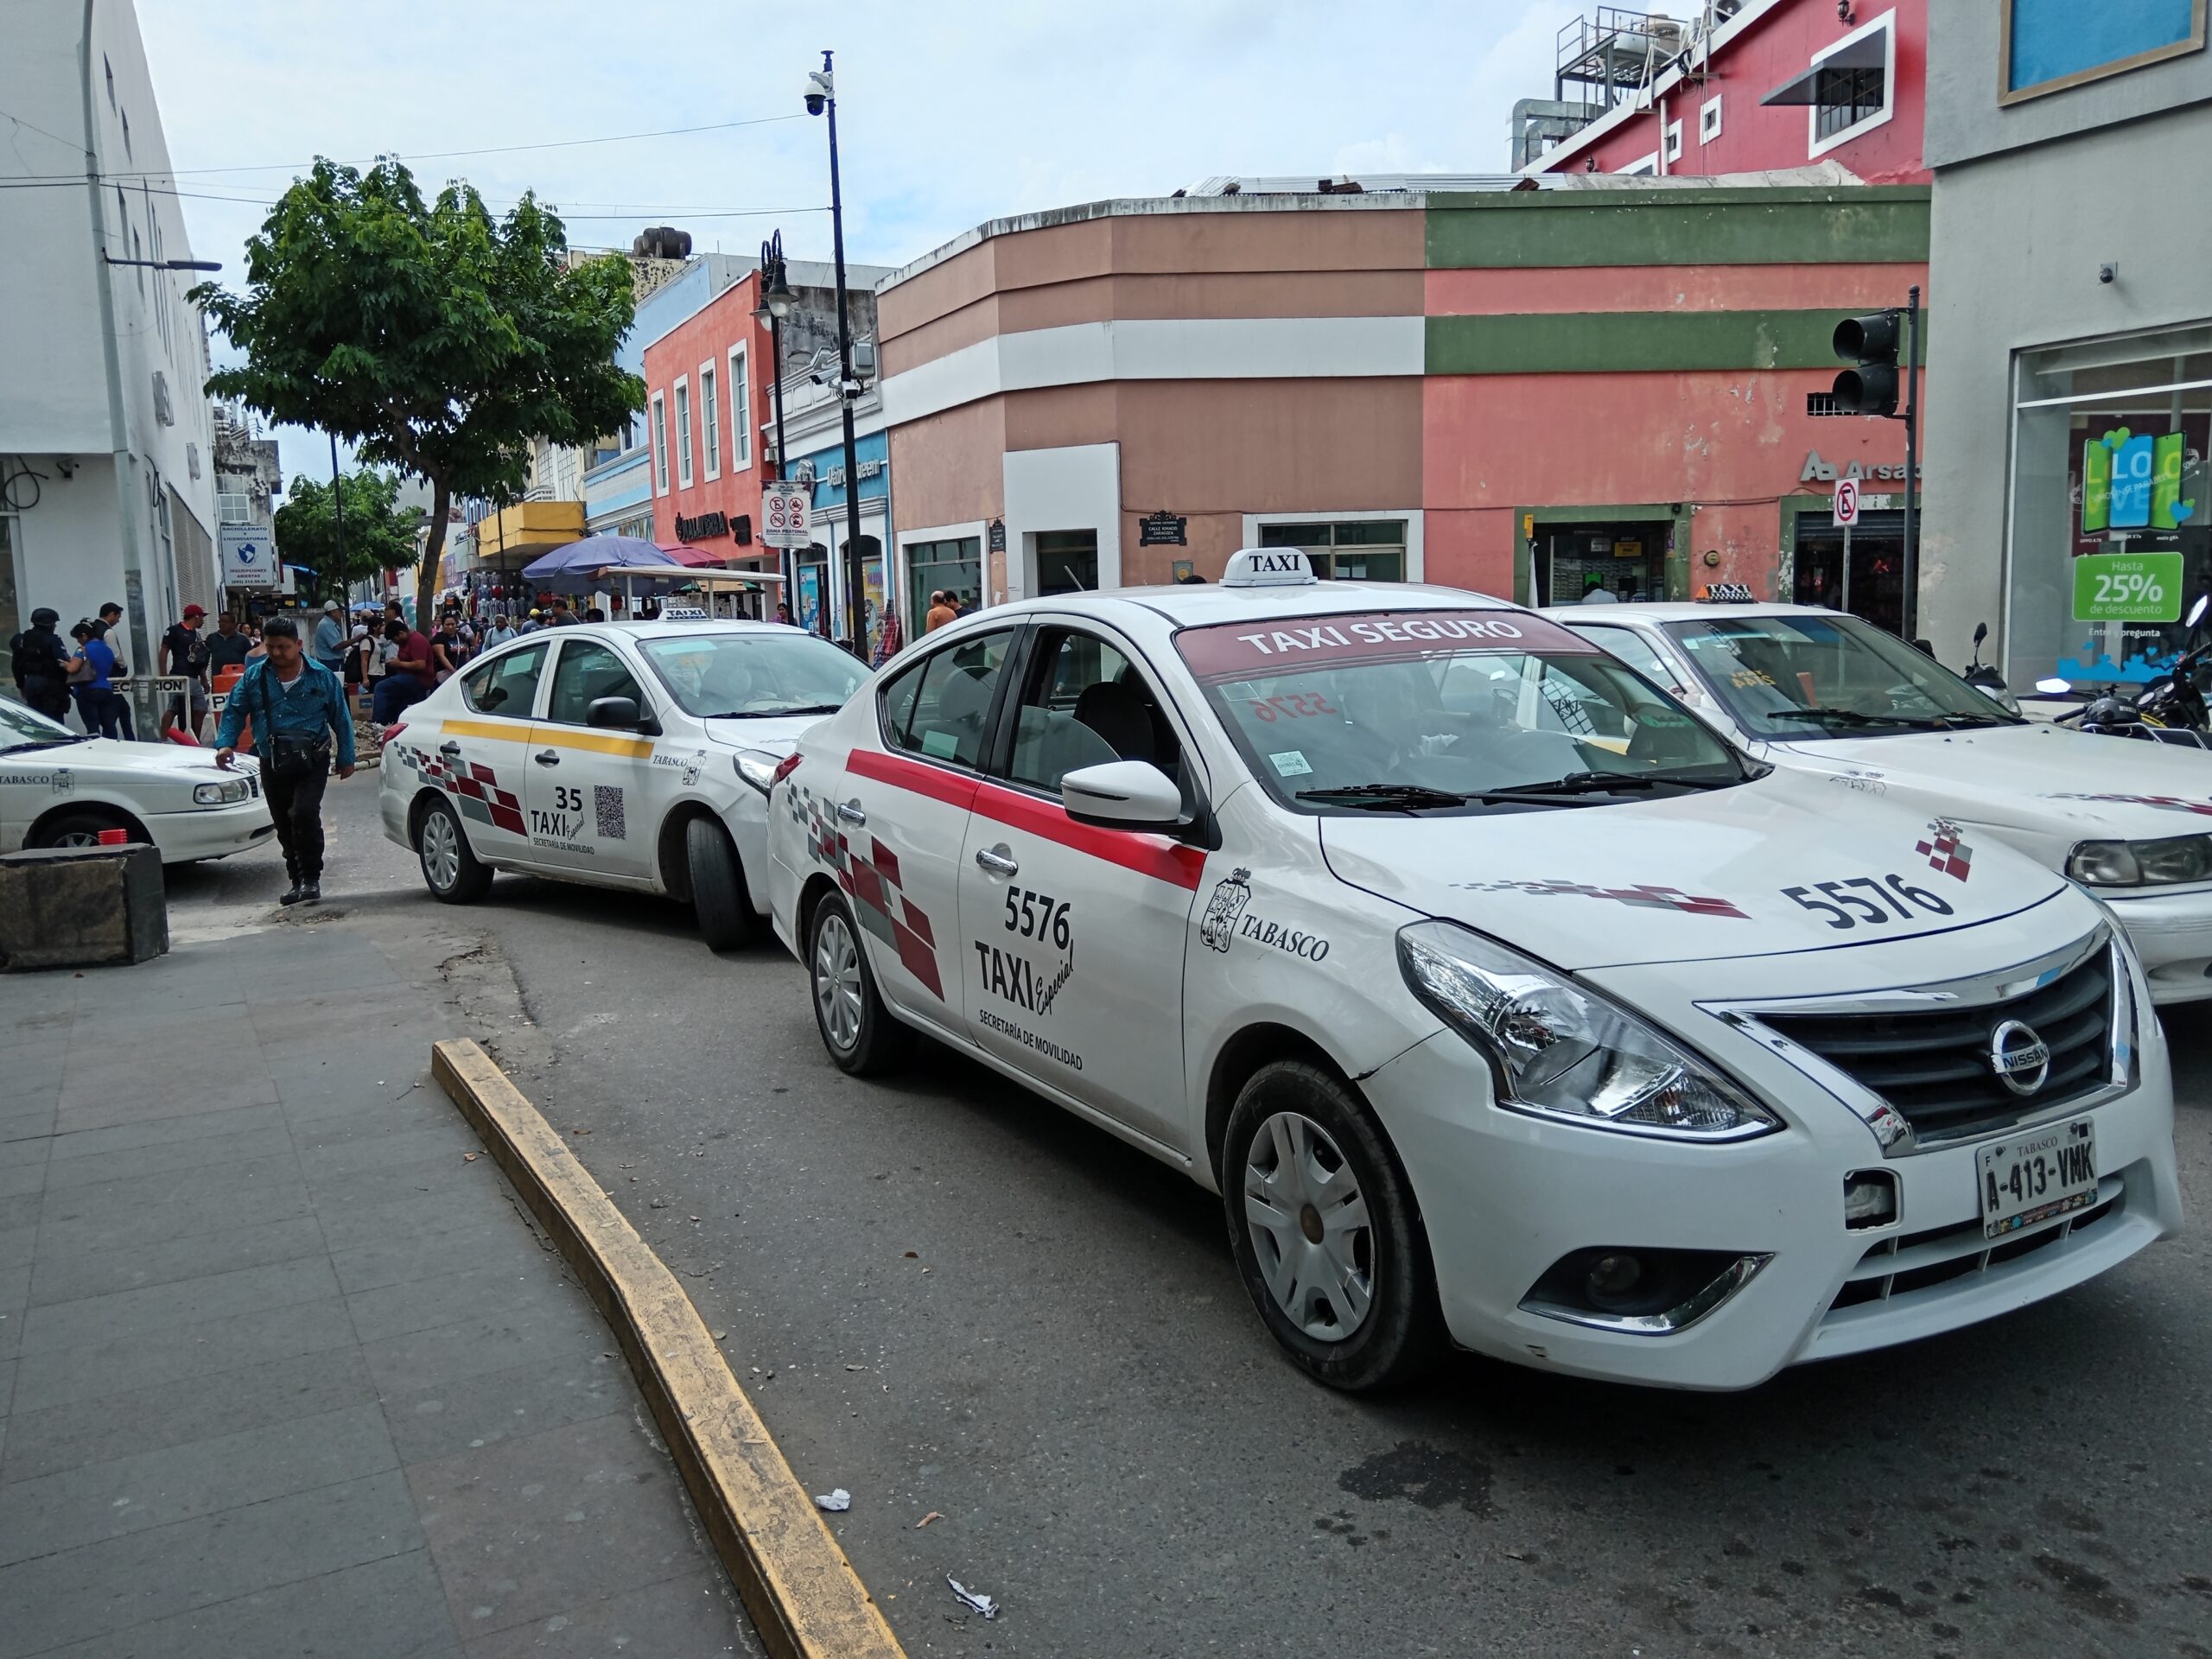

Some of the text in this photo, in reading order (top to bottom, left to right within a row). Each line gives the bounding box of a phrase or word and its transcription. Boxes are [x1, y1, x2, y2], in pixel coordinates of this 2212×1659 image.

[856, 460, 880, 480] ueen
[1845, 460, 1922, 480] Arsa
[1249, 555, 1300, 572] TAXI
[2112, 561, 2144, 571] Hasta
[1706, 584, 1749, 593] TAXI
[2094, 574, 2164, 602] 25%
[2089, 604, 2163, 614] de descuento
[1237, 620, 1523, 655] TAXI SEGURO
[2120, 629, 2160, 639] pregunta
[652, 754, 688, 767] TABASCO
[0, 776, 49, 785] TABASCO
[555, 785, 582, 812] 35
[531, 810, 566, 836] TAXI
[533, 837, 594, 855] SECRETARÍA DE MOVILIDAD
[1778, 873, 1955, 930] 5576
[1005, 885, 1071, 950] 5576
[1240, 913, 1330, 962] TABASCO
[975, 938, 1075, 1016] TAXI Especial
[980, 1009, 1083, 1071] SECRETARÍA DE MOVILIDAD
[2003, 1048, 2048, 1069] NISSAN
[2017, 1136, 2058, 1157] TABASCO
[1986, 1141, 2094, 1213] A-413-VMK
